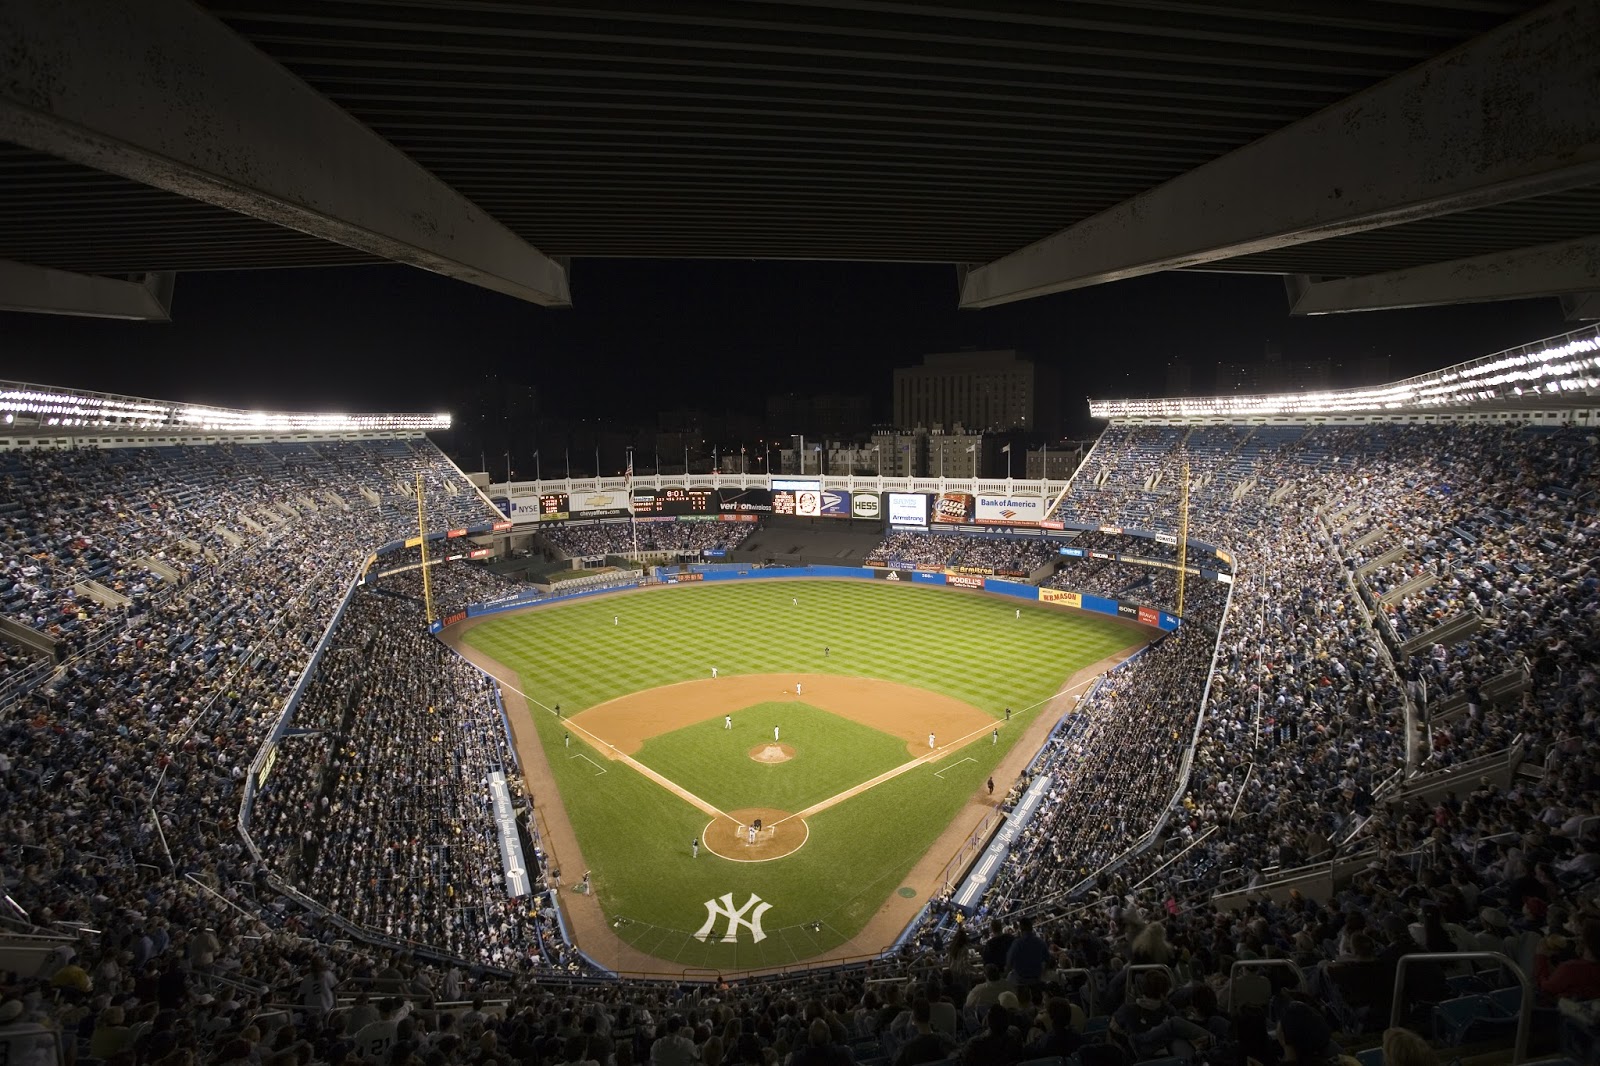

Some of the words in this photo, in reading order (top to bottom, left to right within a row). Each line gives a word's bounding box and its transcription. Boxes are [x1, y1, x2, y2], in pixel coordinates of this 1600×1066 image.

[518, 504, 538, 513] NYSE
[720, 502, 751, 511] verizon
[855, 501, 877, 510] HESS
[942, 500, 965, 509] BUD
[1007, 500, 1036, 508] America
[580, 509, 620, 517] chevyoffers.com
[938, 505, 967, 516] LIGHT
[892, 514, 924, 522] Armstrong
[960, 566, 993, 575] Armitron
[948, 576, 982, 586] MODELL'S
[1119, 606, 1136, 614] SONY
[442, 611, 466, 627] Canon
[1139, 610, 1157, 620] BRAVIA
[998, 827, 1014, 844] York
[1007, 809, 1027, 830] Yankees
[693, 892, 773, 943] NY
[371, 1037, 390, 1056] 21
